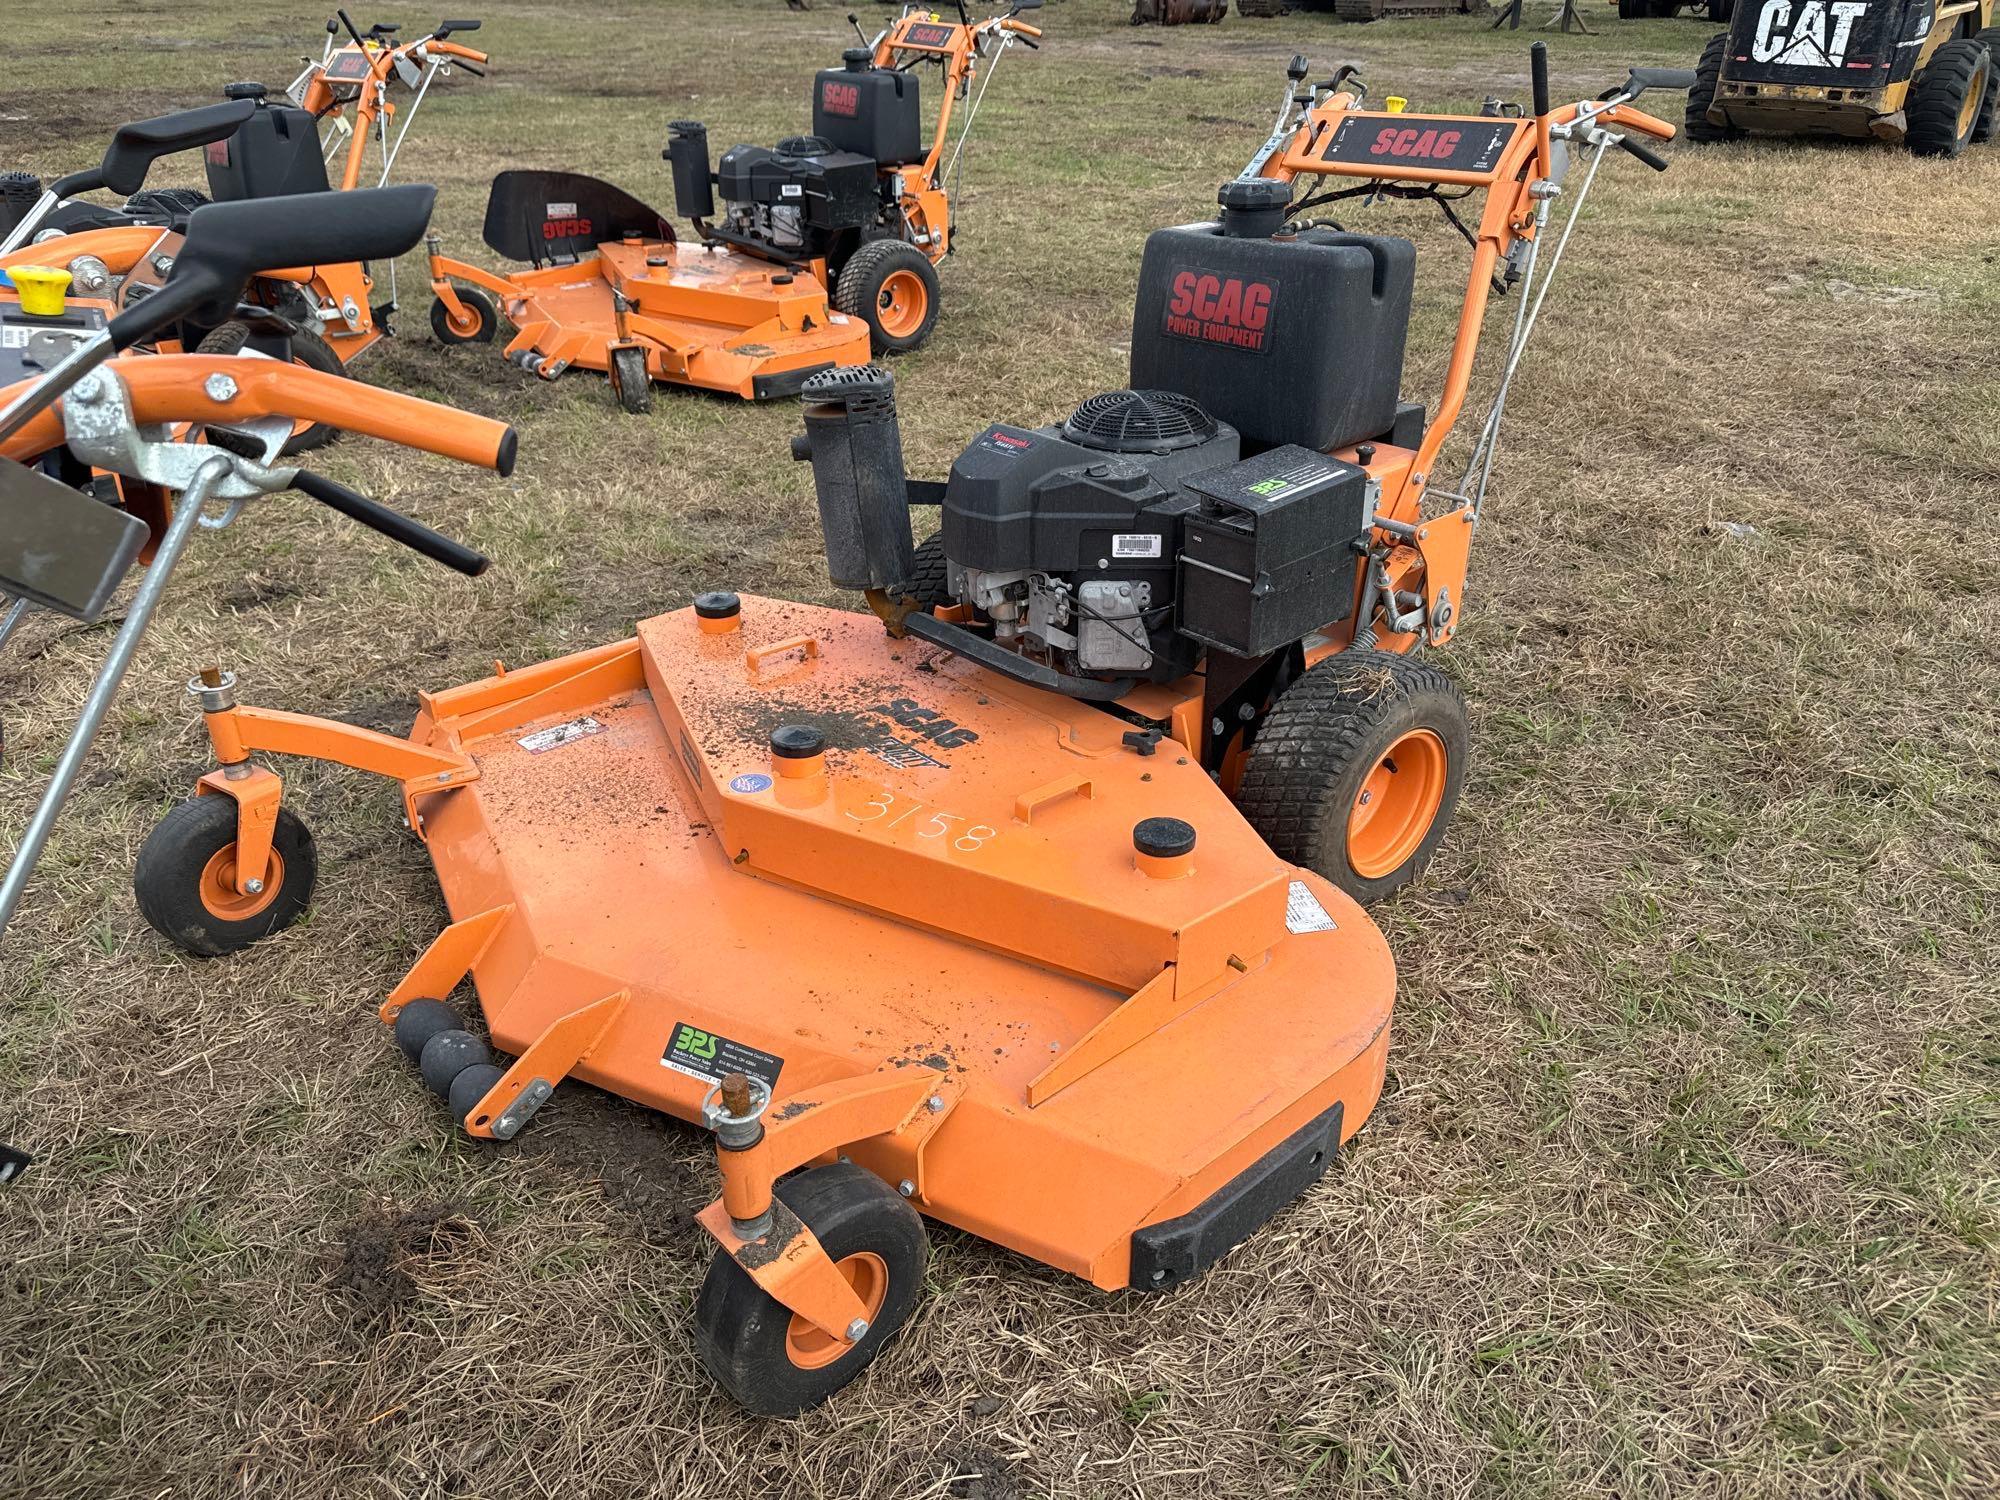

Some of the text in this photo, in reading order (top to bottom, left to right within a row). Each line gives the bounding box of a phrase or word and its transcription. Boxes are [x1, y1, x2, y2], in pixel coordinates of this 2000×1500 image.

[1751, 0, 1867, 68] CAT
[824, 82, 857, 107] SCAG
[1370, 128, 1462, 159] SCAG
[543, 219, 592, 239] SCAG
[1169, 271, 1272, 330] SCAG
[1167, 315, 1265, 350] POWER EQUIPMENT
[872, 698, 979, 749] SCAG
[845, 793, 996, 851] 3158
